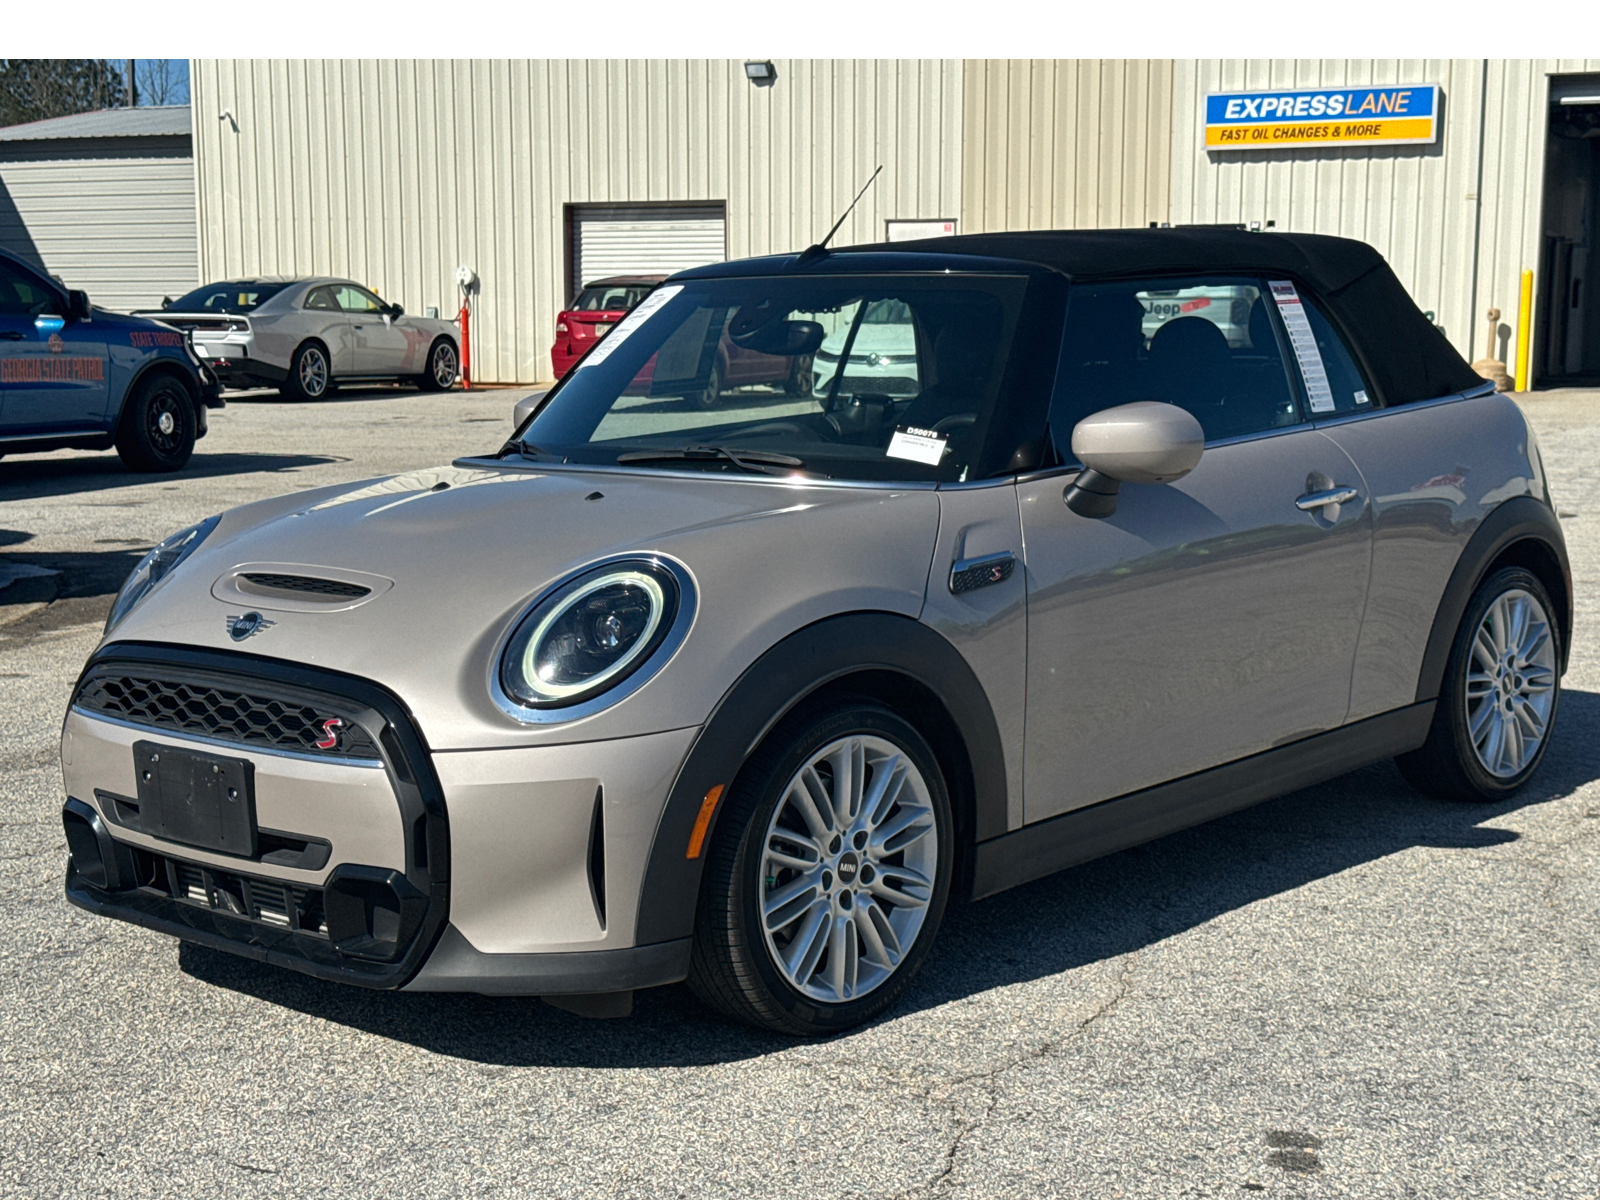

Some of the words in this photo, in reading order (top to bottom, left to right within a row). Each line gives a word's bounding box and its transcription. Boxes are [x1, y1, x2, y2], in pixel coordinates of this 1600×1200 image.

[1220, 129, 1250, 141] FAST
[1252, 128, 1270, 140] OIL
[1273, 126, 1329, 139] CHANGES
[1331, 126, 1341, 137] &
[1344, 124, 1381, 136] MORE
[1145, 301, 1181, 316] Jeep
[129, 331, 154, 347] STATE
[1, 358, 43, 383] GEORGIA
[43, 357, 71, 382] STATE
[73, 356, 105, 381] PATROL
[989, 566, 1001, 582] S
[235, 620, 255, 630] MINI
[316, 718, 343, 750] S
[840, 862, 856, 873] MINI
